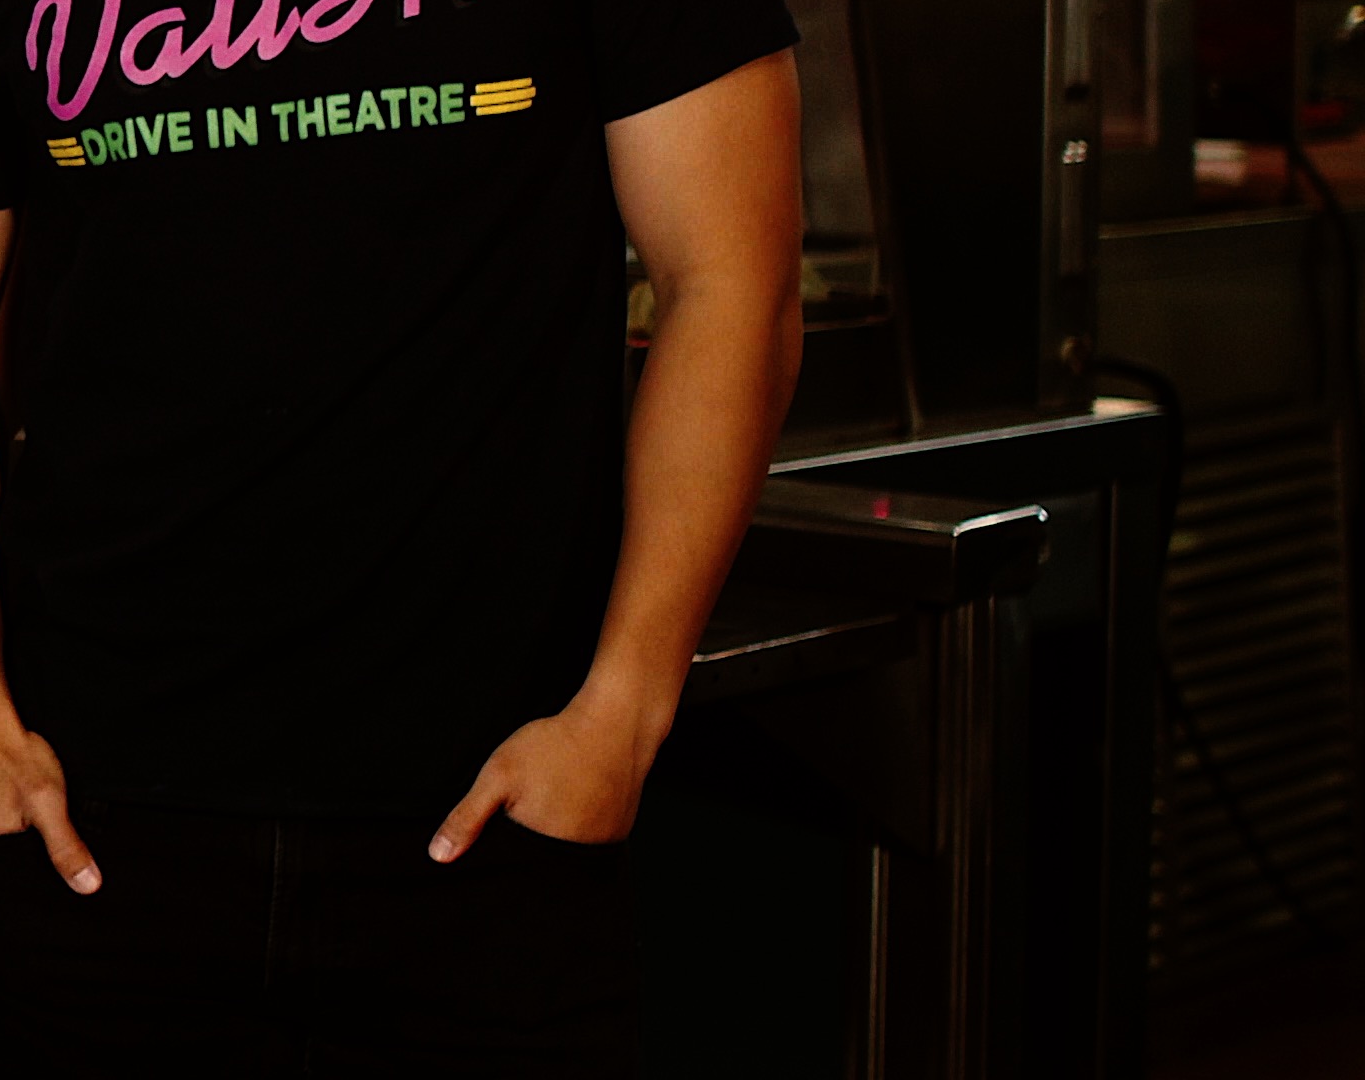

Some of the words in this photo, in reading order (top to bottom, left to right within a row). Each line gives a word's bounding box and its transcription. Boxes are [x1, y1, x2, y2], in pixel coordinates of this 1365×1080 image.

[80, 110, 194, 166] DRIVE
[206, 105, 259, 149] IN
[271, 82, 466, 143] THEATRE
